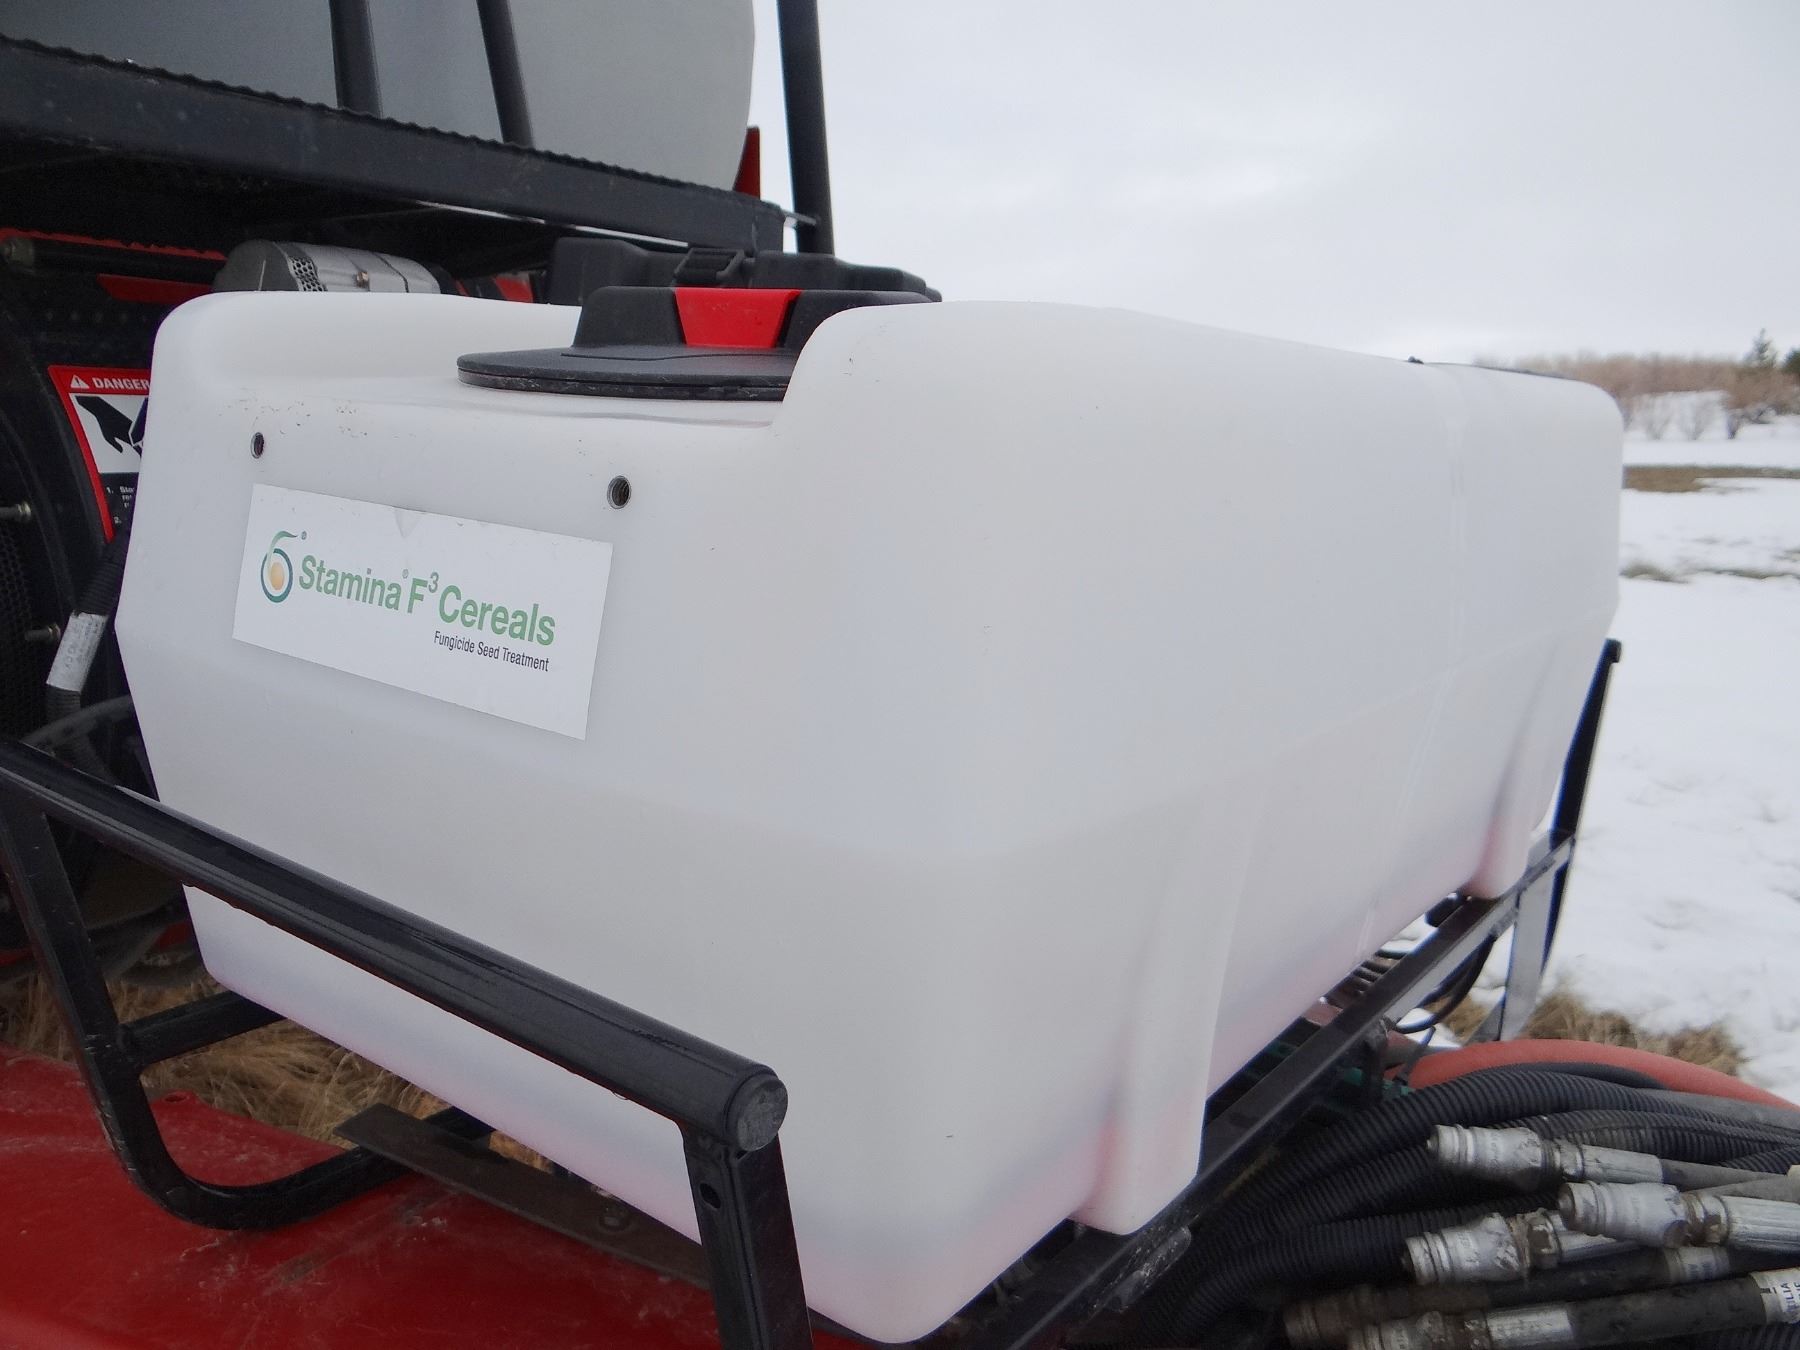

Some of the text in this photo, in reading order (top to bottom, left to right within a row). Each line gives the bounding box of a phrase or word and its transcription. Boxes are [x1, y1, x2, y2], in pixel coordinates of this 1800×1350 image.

[92, 377, 150, 390] DANGER
[439, 584, 556, 646] Cereals
[433, 630, 549, 672] Fungicide Seed Treatment
